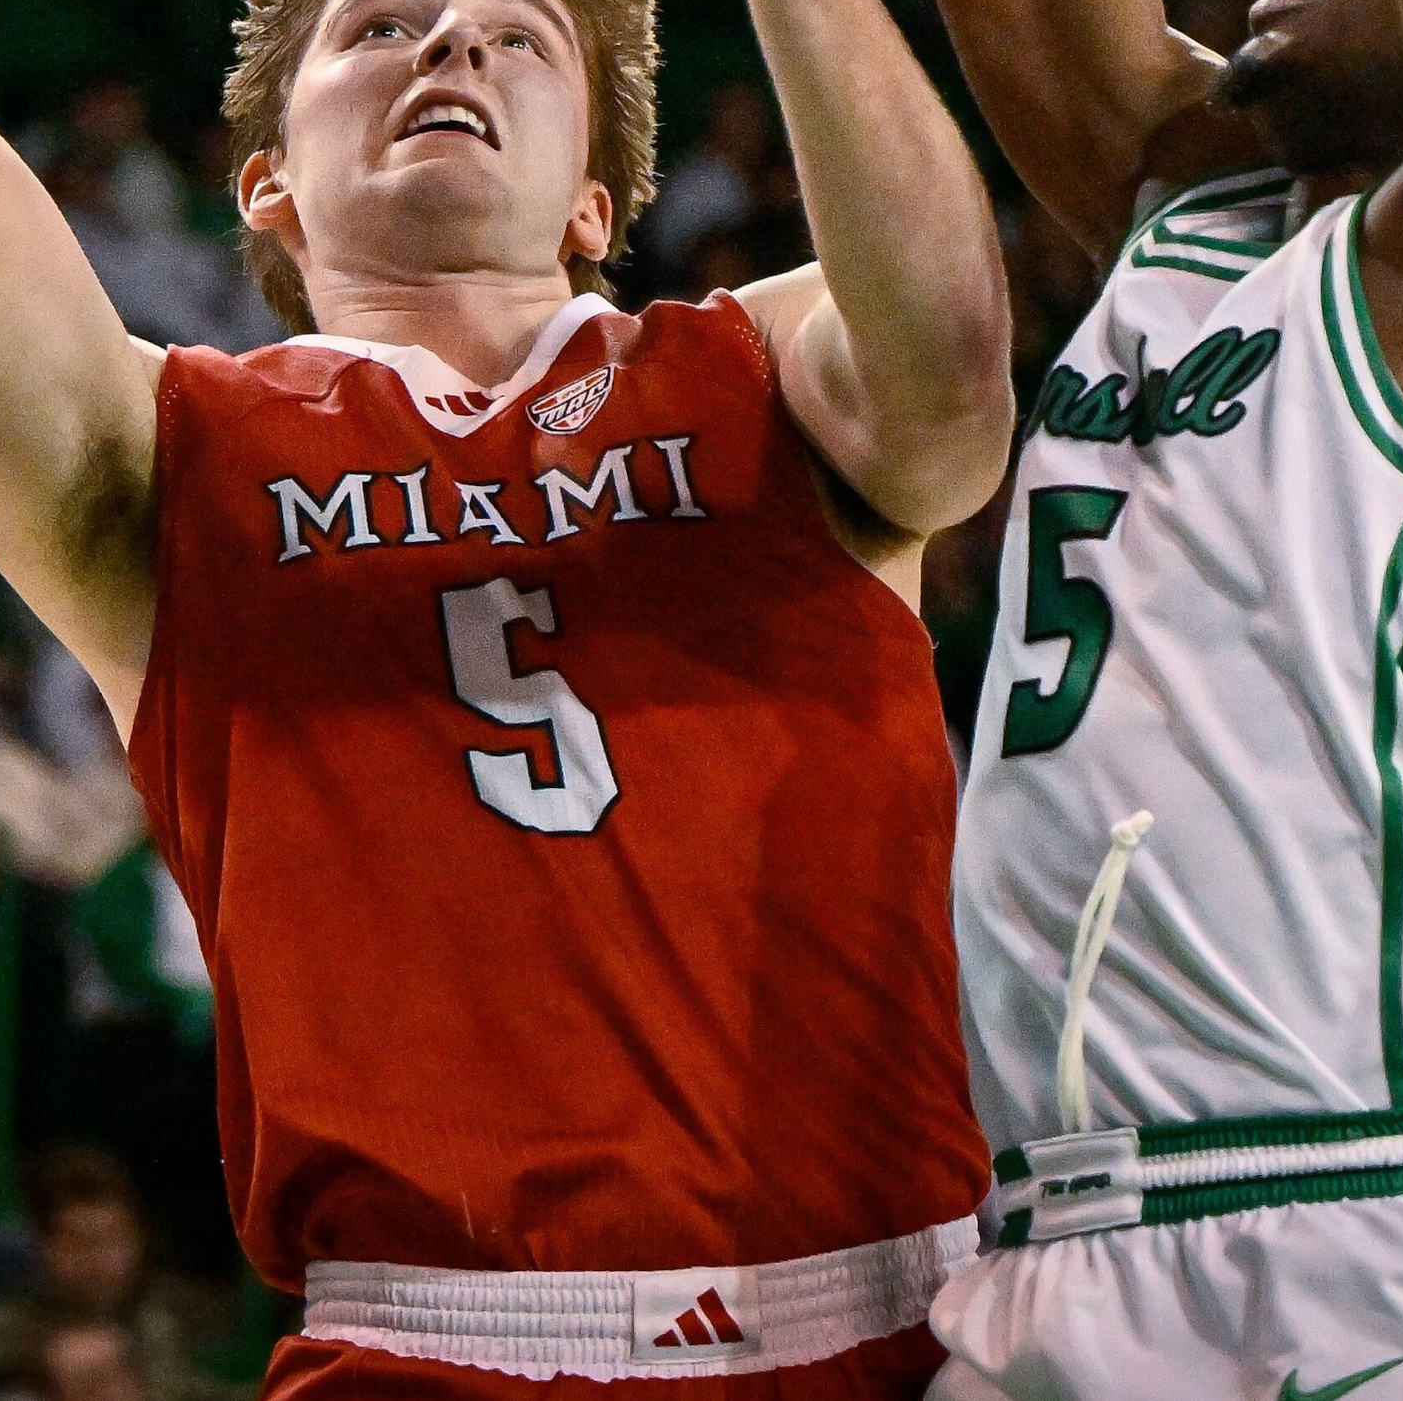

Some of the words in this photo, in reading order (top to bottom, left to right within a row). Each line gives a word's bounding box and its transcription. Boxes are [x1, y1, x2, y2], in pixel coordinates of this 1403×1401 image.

[268, 436, 707, 563] MIAMI
[1001, 485, 1129, 756] 5
[440, 578, 619, 833] 5
